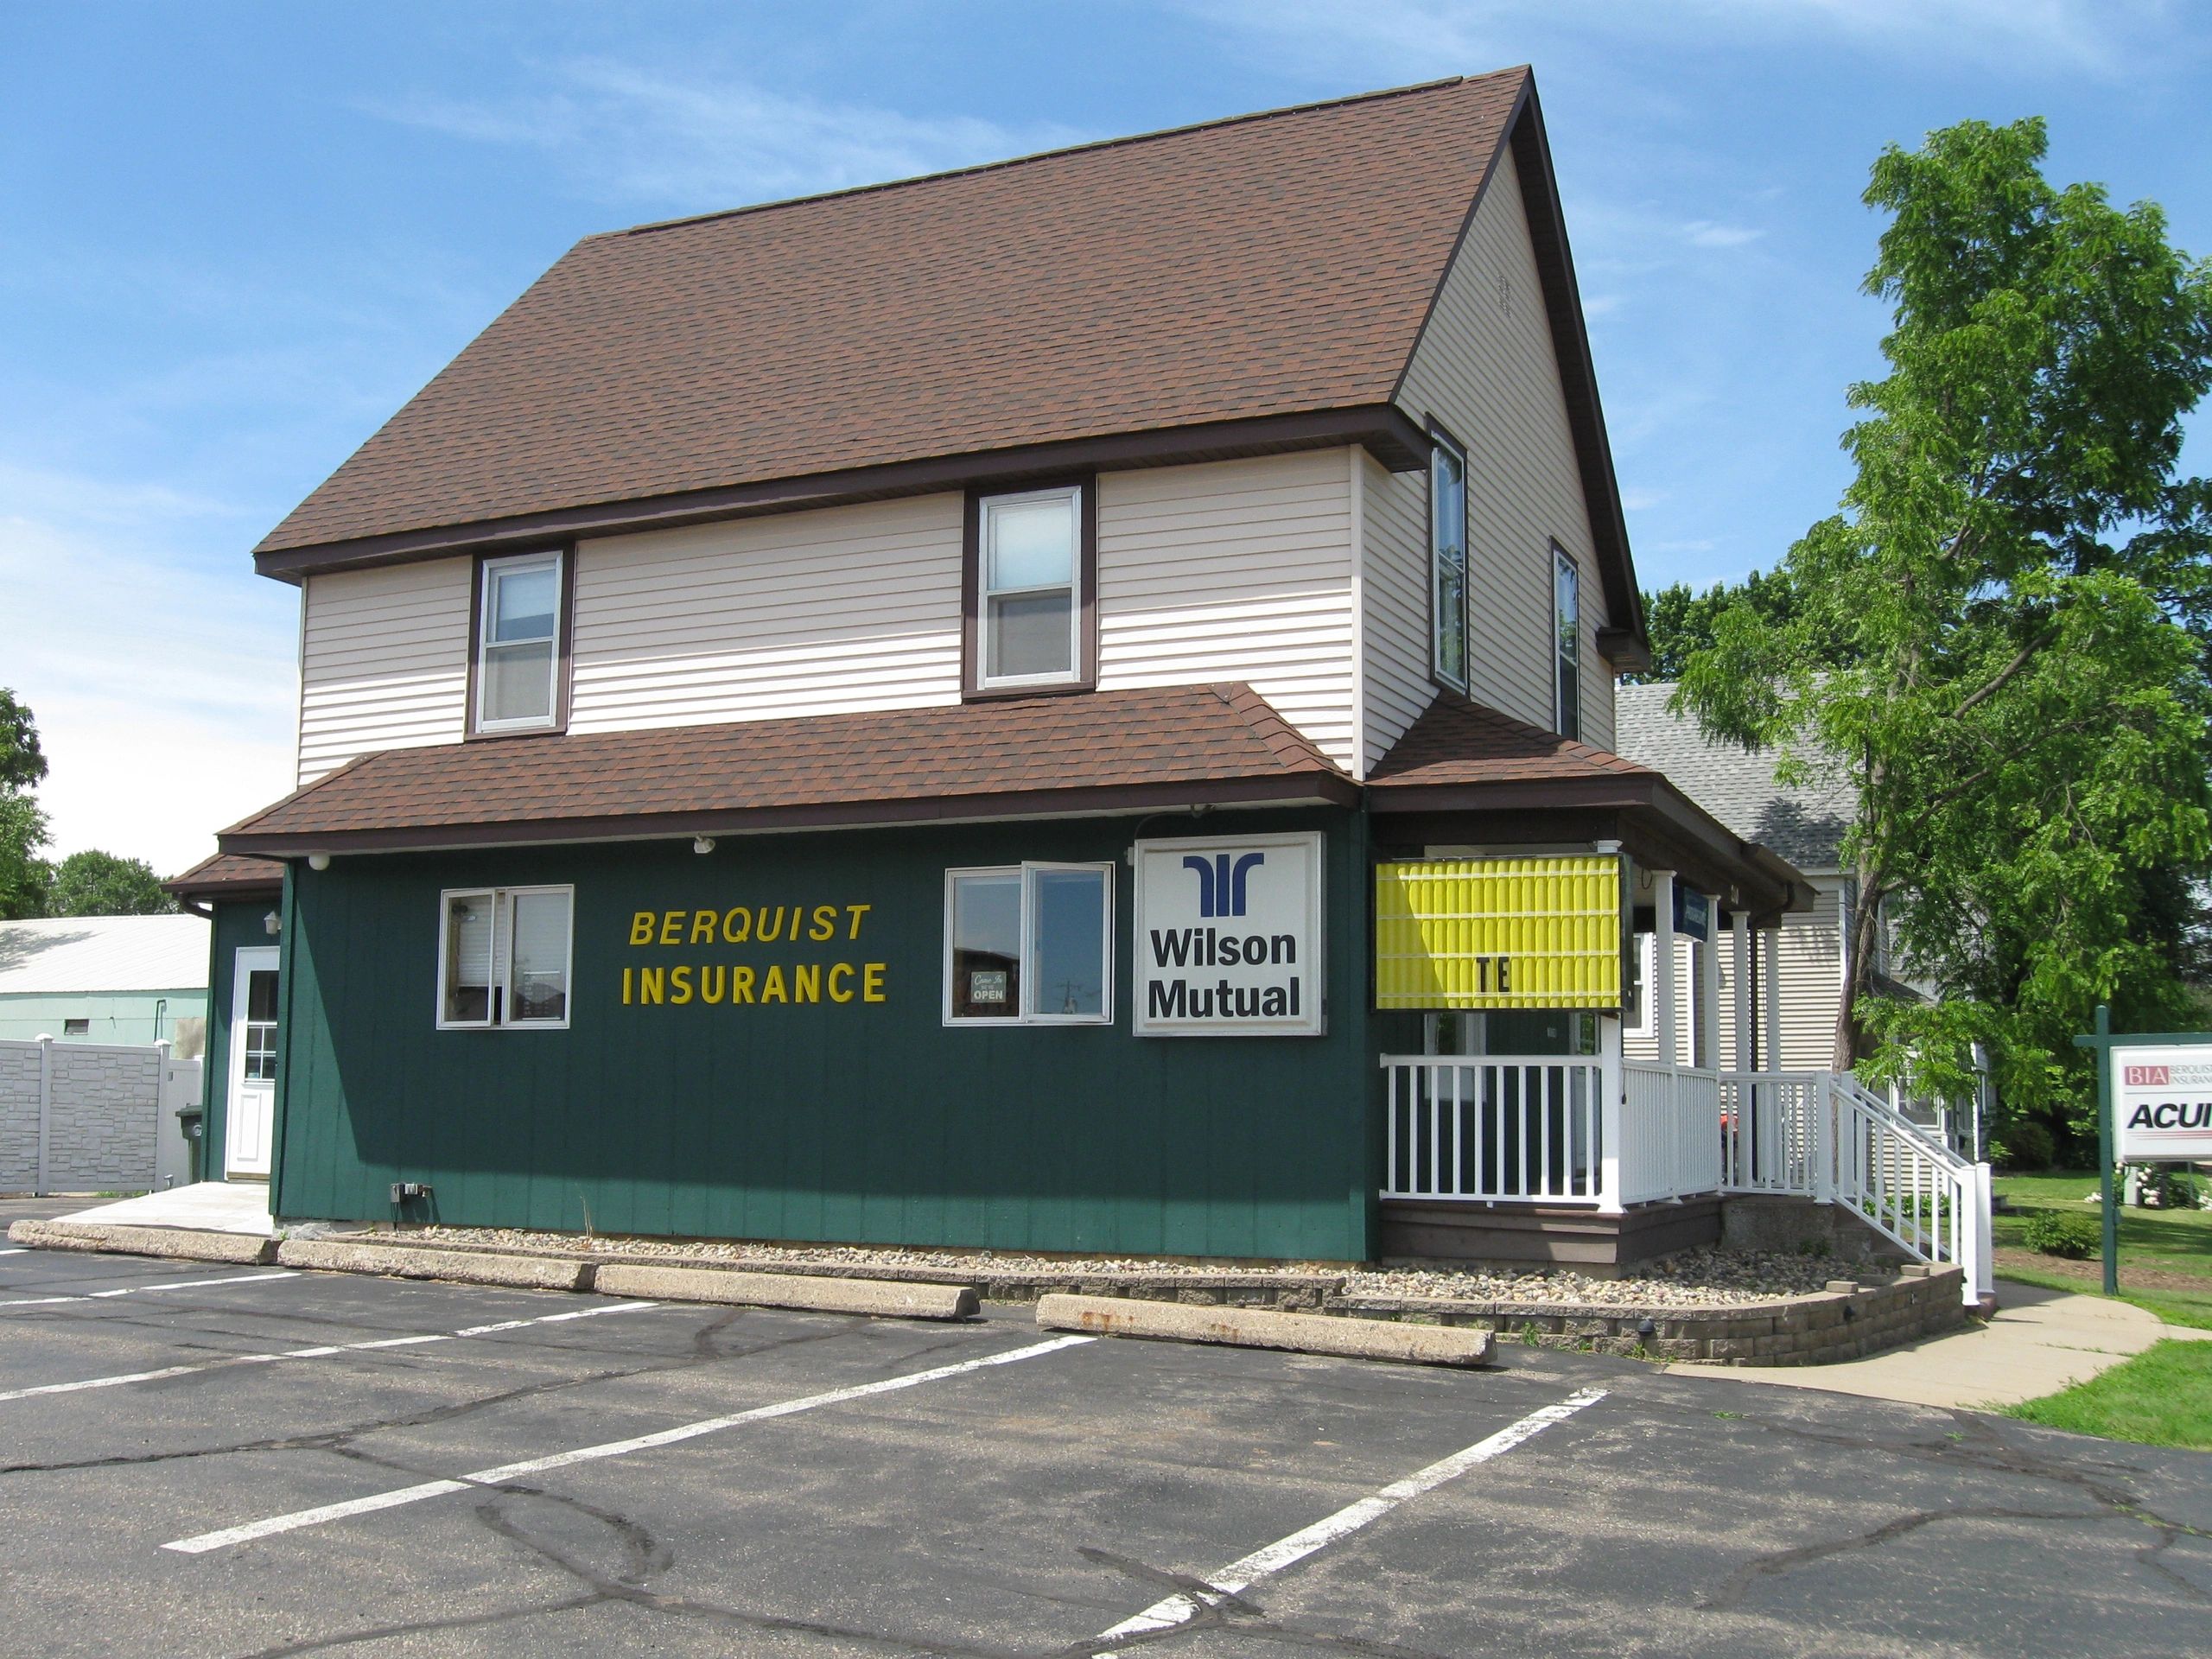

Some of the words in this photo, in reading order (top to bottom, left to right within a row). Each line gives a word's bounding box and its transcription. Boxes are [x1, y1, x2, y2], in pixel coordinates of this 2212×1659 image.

[628, 904, 872, 945] BERQUIST
[1149, 927, 1296, 968] Wilson
[622, 963, 887, 1005] INSURANCE
[974, 990, 1003, 1000] OPEN
[1476, 956, 1510, 993] TE
[1148, 976, 1300, 1019] Mutual
[2128, 1066, 2168, 1085] BIA
